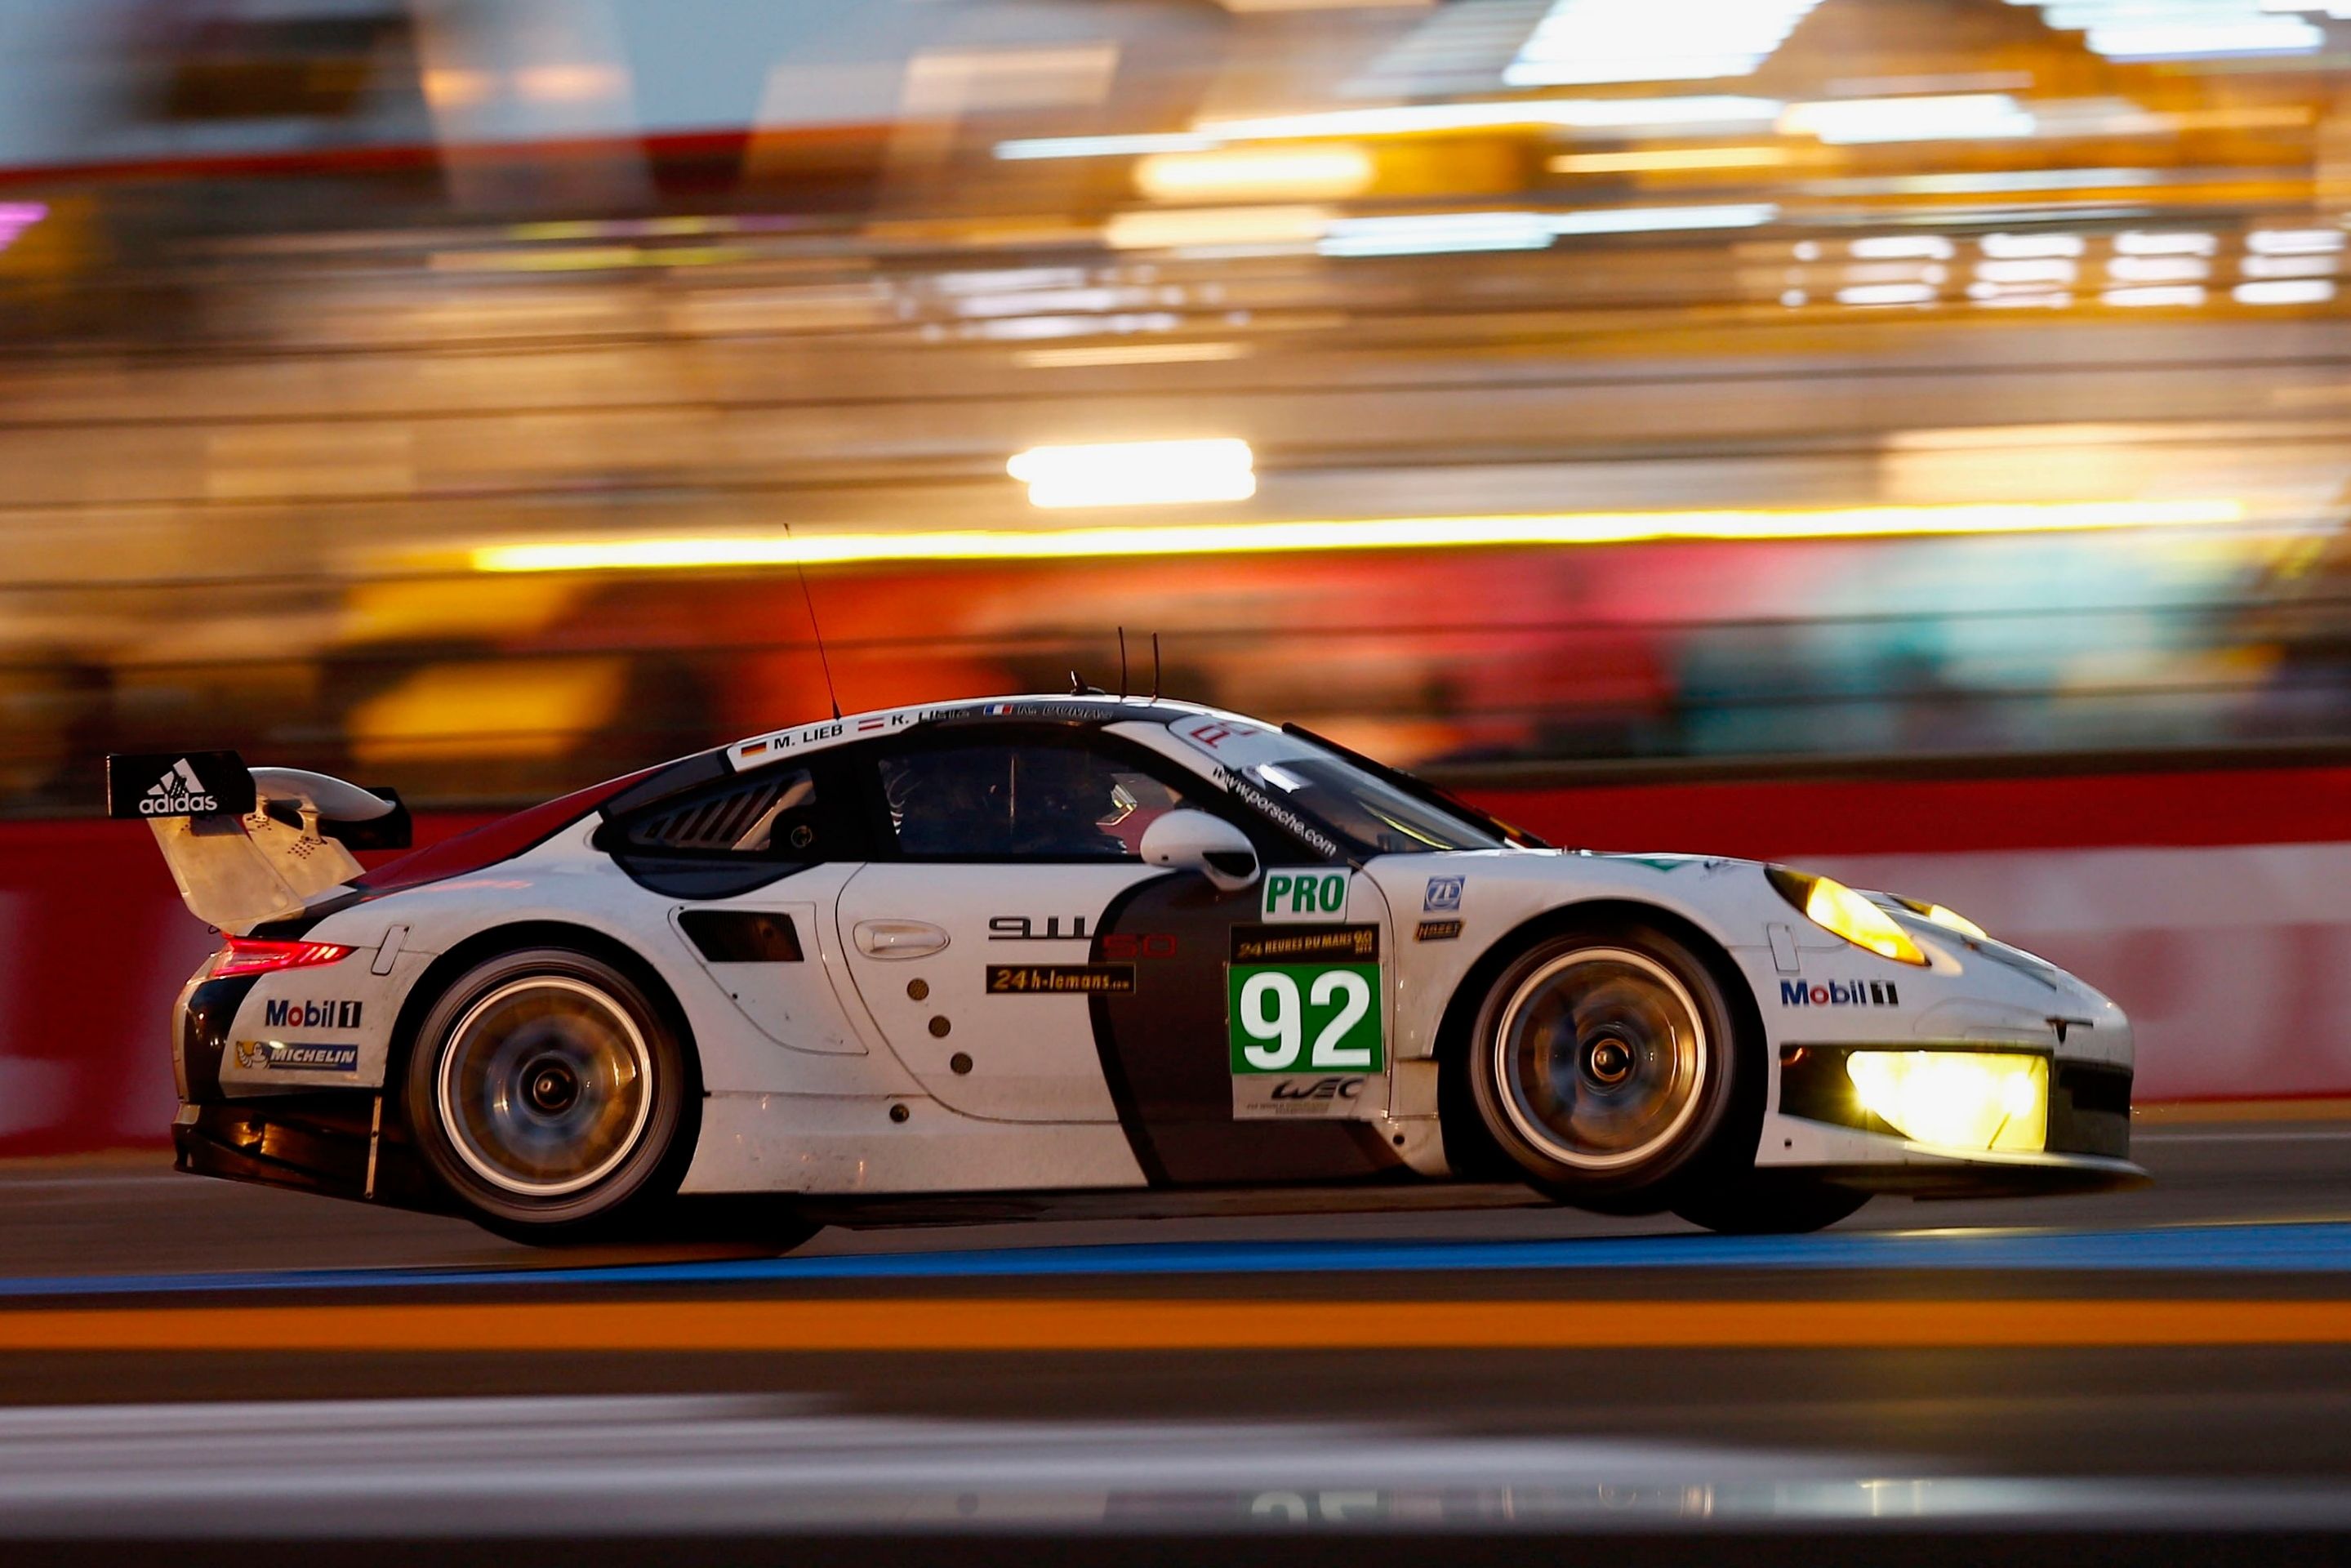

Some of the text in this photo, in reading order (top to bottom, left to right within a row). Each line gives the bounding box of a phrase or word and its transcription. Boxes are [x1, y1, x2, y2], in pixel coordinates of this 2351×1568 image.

[774, 724, 843, 750] M. LIEB
[139, 793, 217, 813] adidas
[1267, 874, 1345, 913] PRO
[988, 915, 1087, 941] 911
[1238, 941, 1262, 959] 24
[1304, 936, 1321, 949] DU
[1780, 979, 1867, 1006] Mobil
[265, 1000, 336, 1027] Mobil
[1240, 969, 1371, 1070] 92
[270, 1049, 356, 1063] MICHELIN
[1271, 1076, 1365, 1100] WEC
